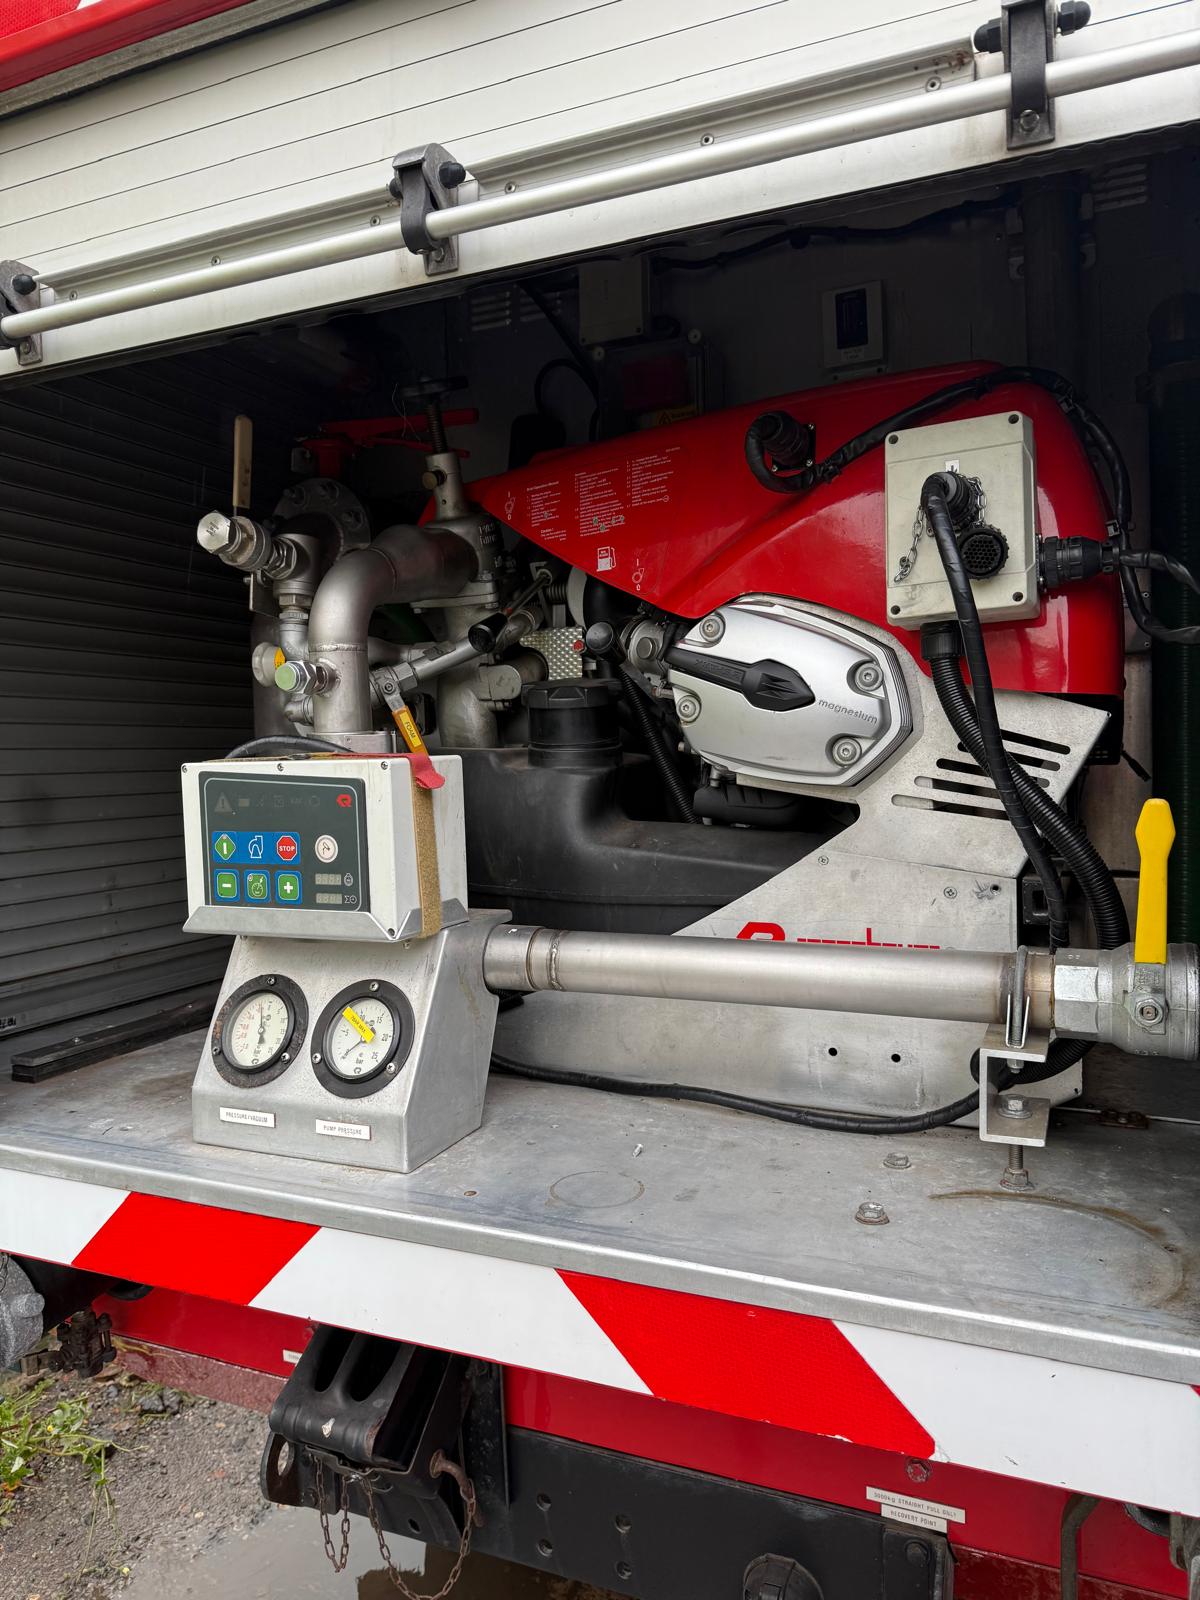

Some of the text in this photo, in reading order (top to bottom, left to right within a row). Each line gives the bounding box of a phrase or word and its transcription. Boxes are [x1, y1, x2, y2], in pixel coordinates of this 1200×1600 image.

[818, 698, 878, 725] magnesium
[405, 721, 416, 739] FOAM
[225, 1111, 268, 1123] PRESSURE/VACUUM
[323, 1124, 362, 1135] PUMP PRESSURE
[898, 1497, 924, 1508] STRAIGHT
[927, 1505, 940, 1514] PULL
[943, 1510, 957, 1518] ONLY
[890, 1510, 937, 1527] RECOVERY POINT
